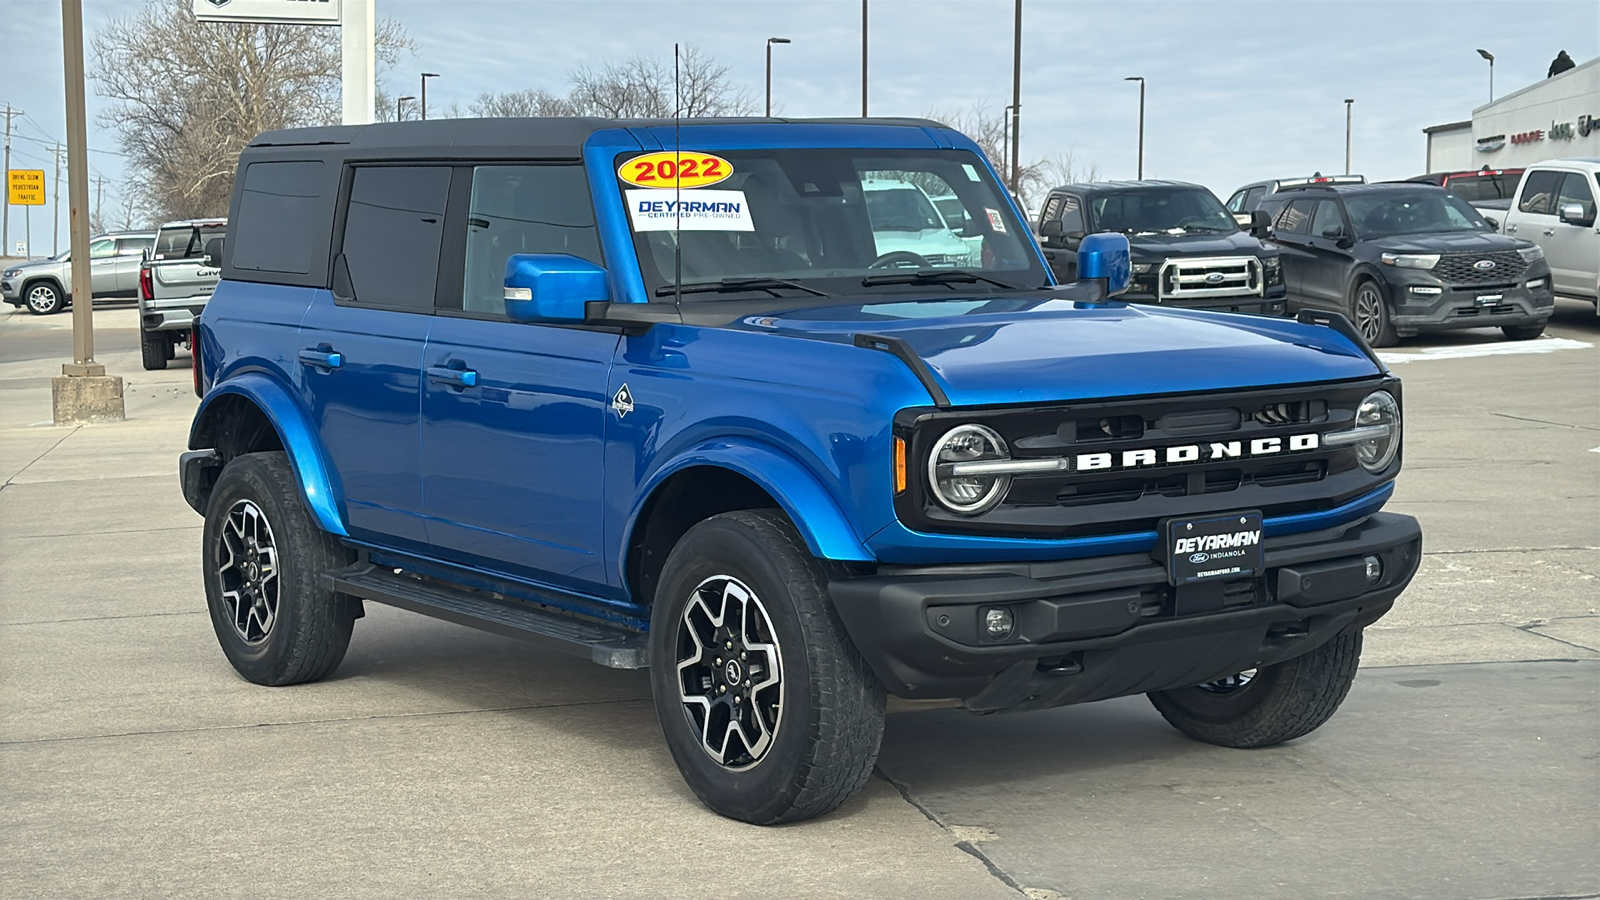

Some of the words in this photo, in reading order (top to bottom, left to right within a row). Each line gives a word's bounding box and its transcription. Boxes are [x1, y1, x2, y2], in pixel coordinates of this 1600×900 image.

[634, 158, 723, 182] 2022
[638, 200, 741, 213] DEYARMAN
[1076, 433, 1319, 471] BRONCO
[1174, 530, 1261, 555] DEYARMAN
[1210, 549, 1246, 560] INDIANOLA
